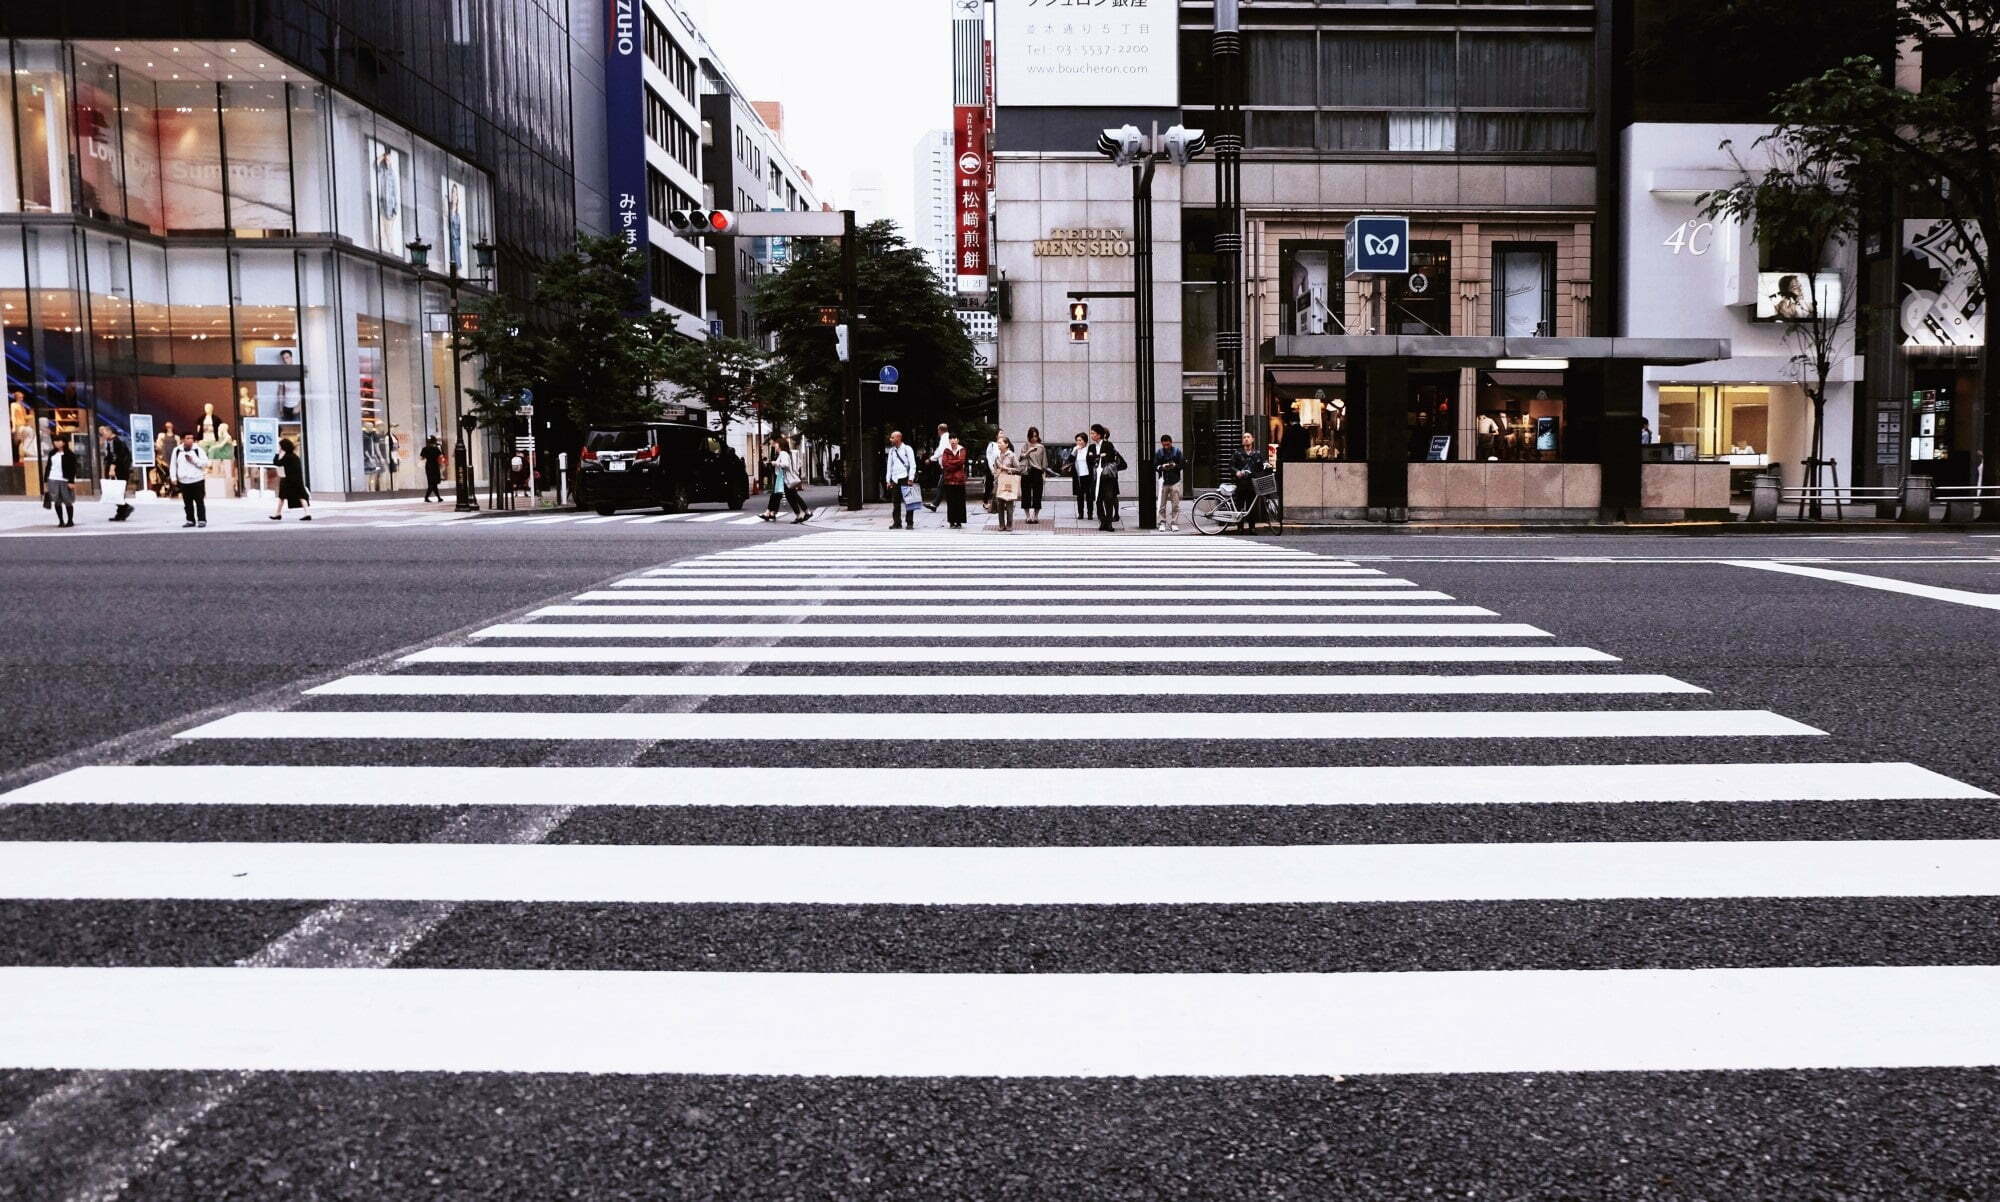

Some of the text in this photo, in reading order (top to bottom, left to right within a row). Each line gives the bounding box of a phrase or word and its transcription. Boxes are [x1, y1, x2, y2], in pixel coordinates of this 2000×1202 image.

[1026, 63, 1148, 74] www.boucheron.com
[1051, 229, 1123, 240] TEIJIN
[1033, 240, 1087, 257] MEN'S
